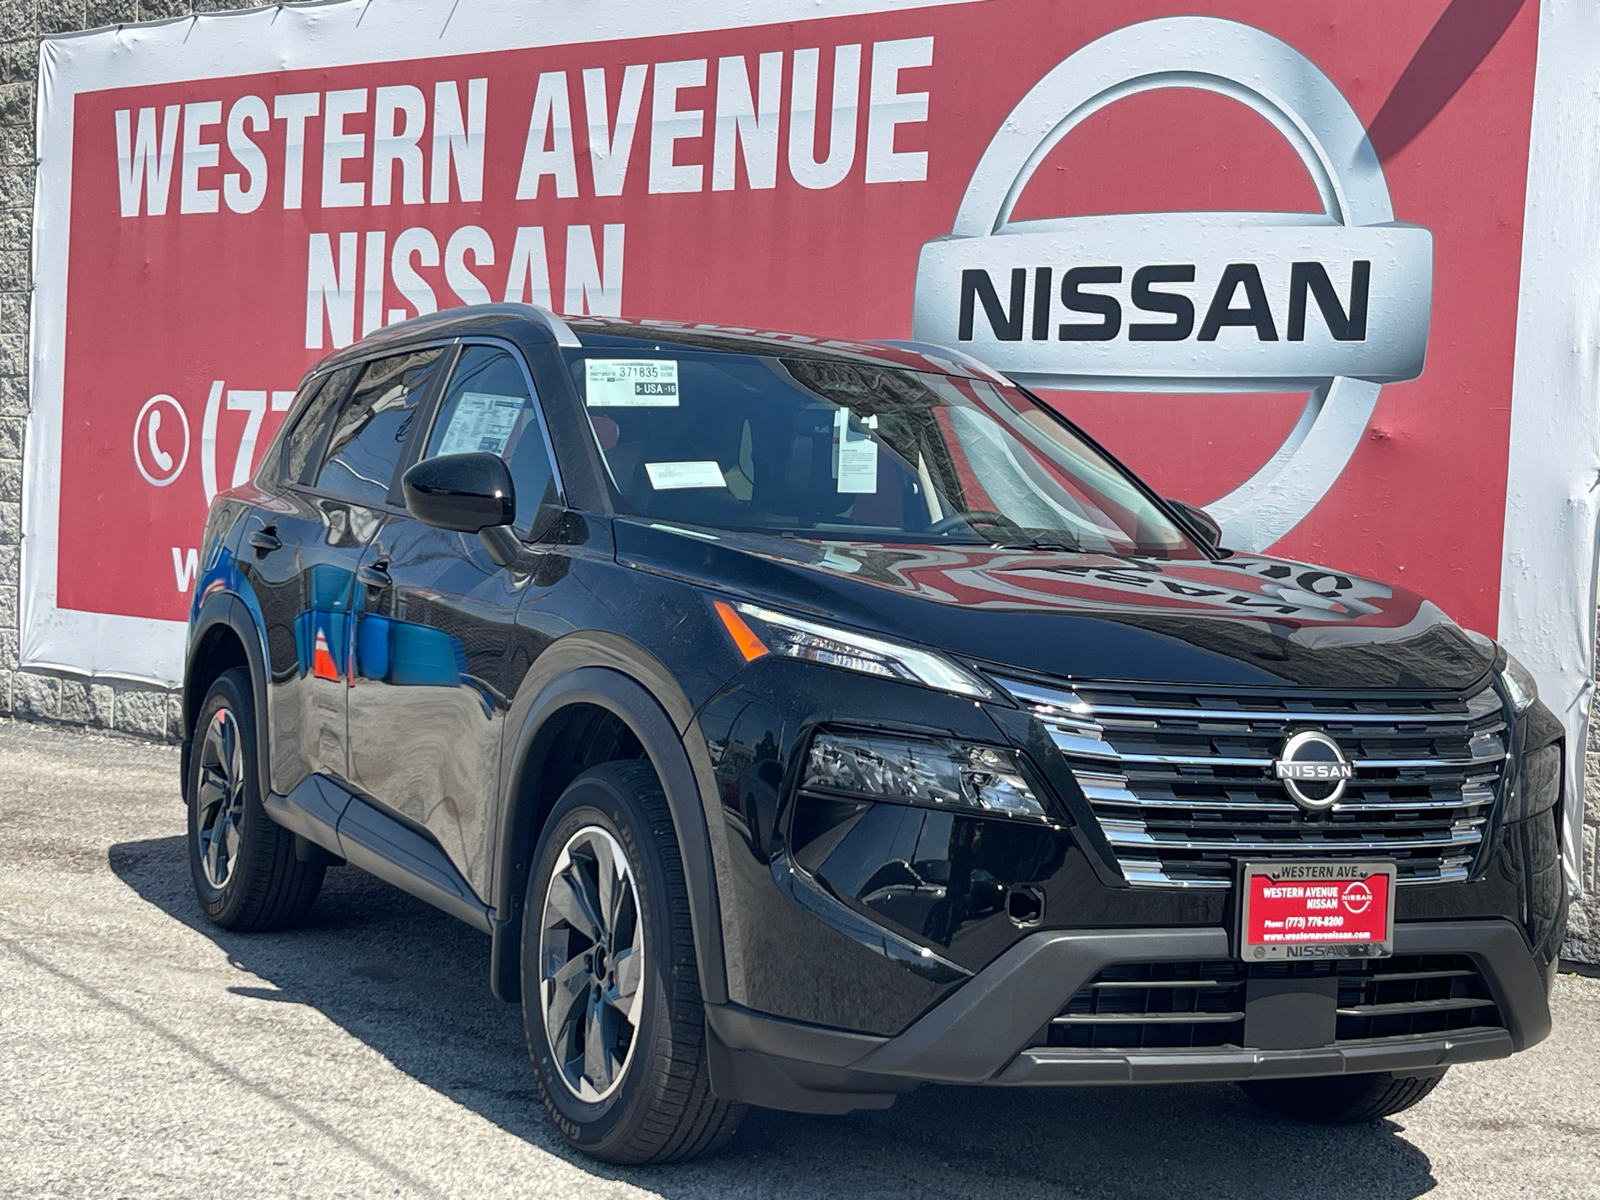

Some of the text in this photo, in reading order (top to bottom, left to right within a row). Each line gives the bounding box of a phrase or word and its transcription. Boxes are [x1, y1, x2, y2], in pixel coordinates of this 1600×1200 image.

[115, 36, 934, 217] WESTERN AVENUE
[305, 223, 626, 349] NISSAN
[958, 260, 1371, 342] NISSAN
[620, 367, 658, 378] 371835
[644, 383, 663, 394] USA
[1279, 765, 1352, 778] NISSAN
[1281, 866, 1333, 878] WESTERN
[1263, 887, 1338, 898] WESTERN AVENUE
[1307, 899, 1338, 909] NISSAN
[1264, 919, 1284, 928] Phone:
[1285, 917, 1306, 930] (773)
[1263, 931, 1371, 941] www.westernavenissan.com
[1287, 945, 1348, 958] NISSAN
